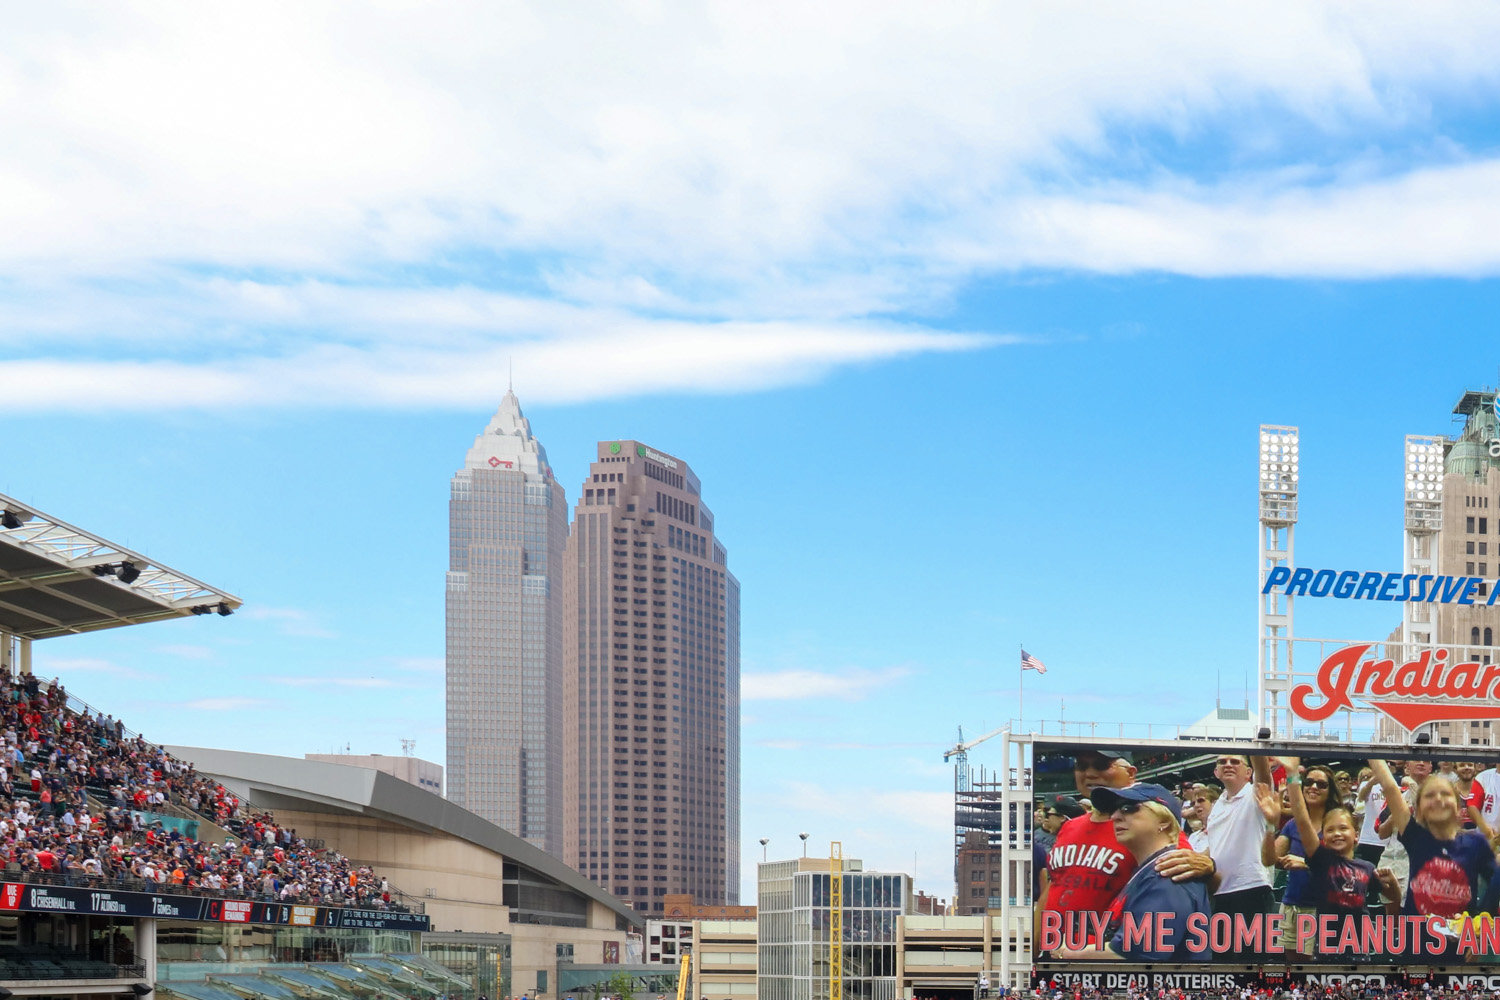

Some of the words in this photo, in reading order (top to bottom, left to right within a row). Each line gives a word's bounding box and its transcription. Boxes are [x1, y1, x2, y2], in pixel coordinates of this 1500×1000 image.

[1262, 566, 1483, 605] PROGRESSIVE
[1049, 844, 1125, 875] INDIANS
[8, 896, 16, 906] UP
[31, 888, 36, 907] 8
[91, 893, 100, 911] 17
[152, 898, 157, 914] 7
[1040, 910, 1113, 952] BUY
[1122, 911, 1176, 952] ME
[1186, 912, 1285, 953] SOME
[1296, 913, 1448, 954] PEANUTS
[1053, 973, 1101, 989] START
[1107, 973, 1148, 989] DEAD
[1153, 973, 1240, 989] BATTERIES.
[1266, 977, 1284, 985] 1914
[1306, 974, 1386, 989] NOCO
